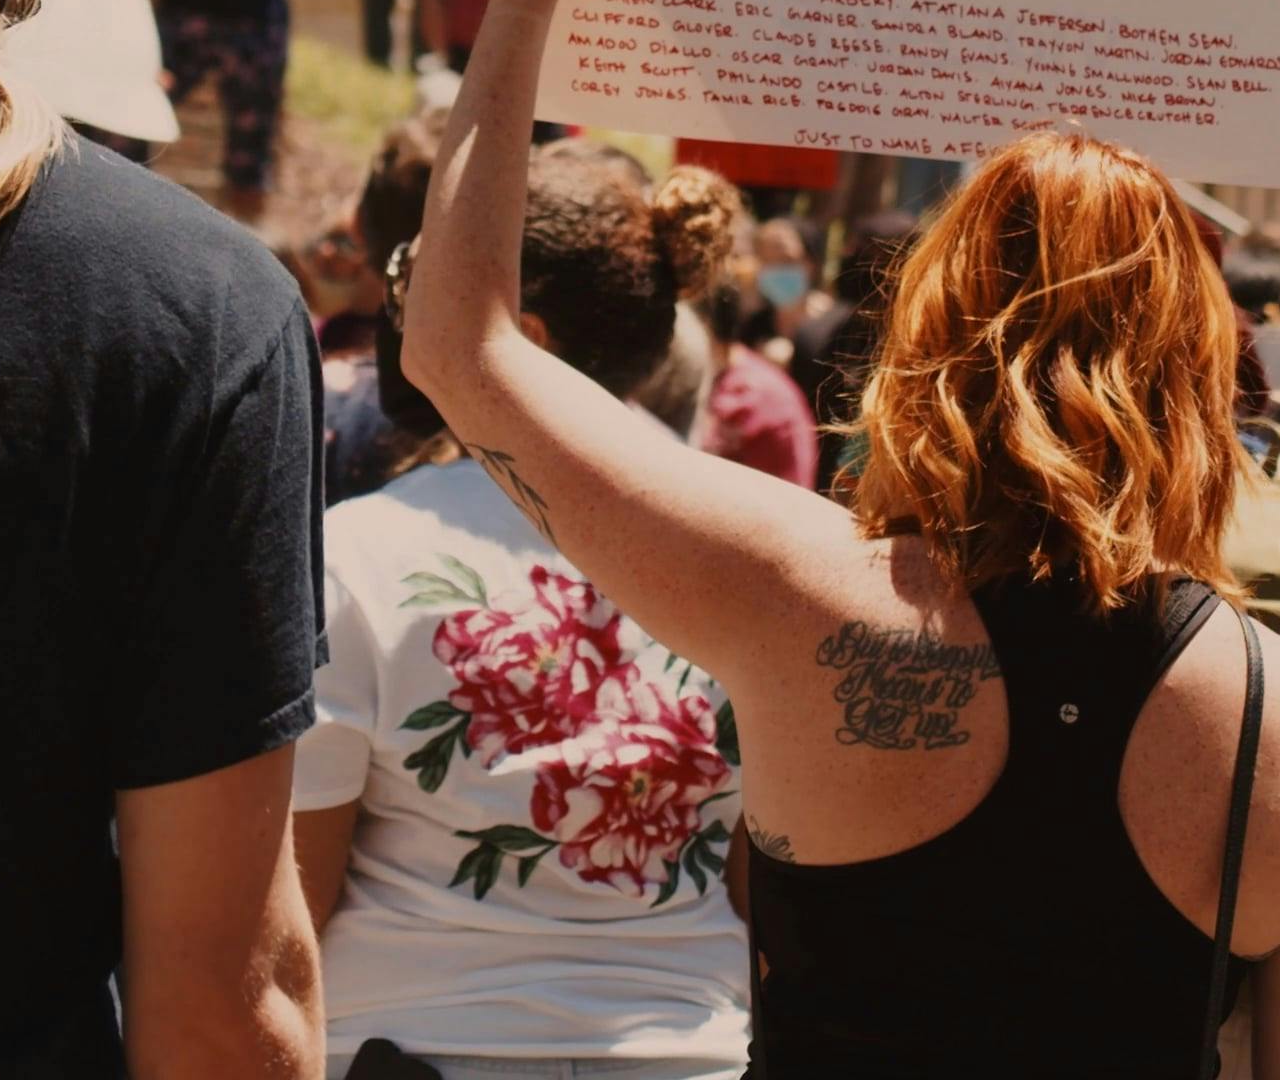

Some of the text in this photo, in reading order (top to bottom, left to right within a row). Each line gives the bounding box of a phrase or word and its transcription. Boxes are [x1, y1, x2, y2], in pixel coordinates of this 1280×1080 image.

[572, 8, 660, 29] CLIFFORD
[672, 20, 738, 38] GLOVER.
[752, 29, 816, 48] CLAUDE
[900, 44, 948, 61] RANDY
[960, 47, 1015, 65] EVANS.
[1084, 66, 1179, 90] SMALLWOOD.
[1186, 75, 1226, 91] SEAN
[1231, 79, 1272, 94] BELL.
[735, 1, 773, 17] ERIC
[787, 7, 863, 28] GARNER.
[871, 19, 937, 35] SANDRA
[947, 24, 1008, 42] BLAND.
[1018, 36, 1084, 53] TRAYVON
[1094, 46, 1153, 61] MARTIN.
[1161, 49, 1212, 66] JORDAN
[910, 0, 1005, 19] ATATIANA
[1017, 8, 1113, 33] JEFFERSON.
[1188, 32, 1237, 50] SEAN.
[568, 32, 637, 51] AMADOU
[731, 50, 782, 65] OSCAR
[793, 54, 856, 69] GRANT.
[867, 61, 925, 76] JORDAN
[990, 76, 1044, 92] AIYANA
[1056, 82, 1110, 99] JONES.
[571, 79, 620, 96] COREY
[702, 90, 753, 106] TAMIR
[579, 56, 626, 73] KEITH
[716, 68, 802, 89] PHILANDO
[817, 81, 887, 96] CASTILE.
[899, 88, 944, 101] ALTON
[957, 90, 1039, 111] STERLING.
[795, 129, 840, 145] JUST
[850, 135, 872, 148] TO
[881, 138, 931, 153] NAME
